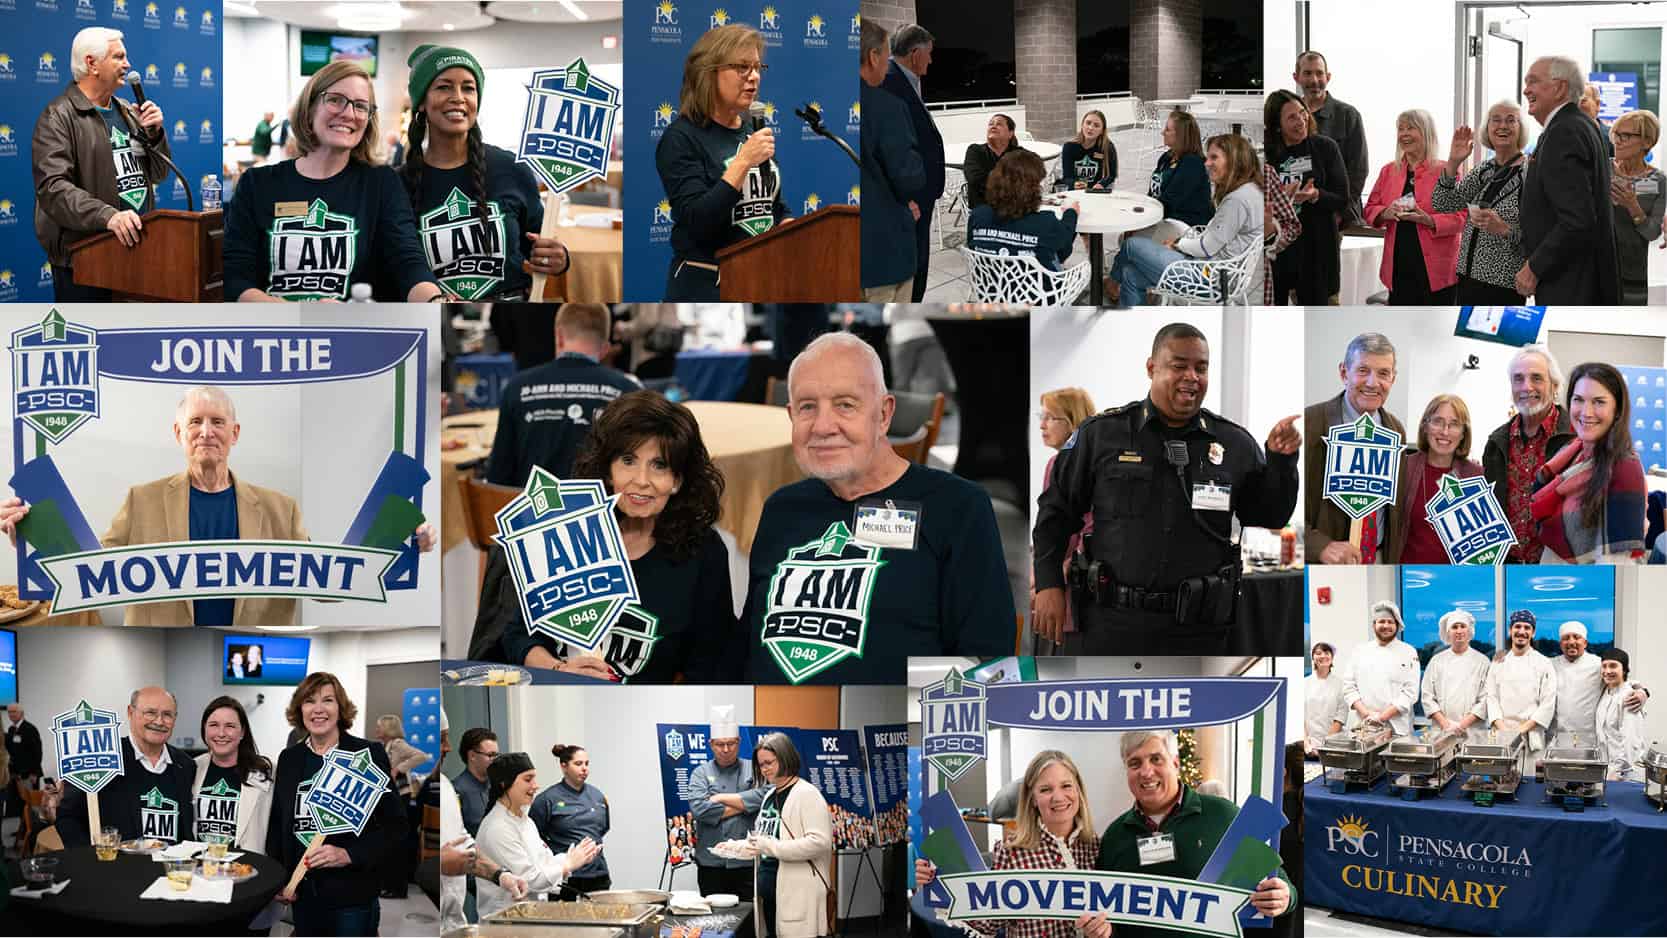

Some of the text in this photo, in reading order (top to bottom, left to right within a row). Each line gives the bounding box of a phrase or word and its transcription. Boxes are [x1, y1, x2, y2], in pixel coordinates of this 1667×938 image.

[655, 6, 679, 25] PSC
[806, 20, 827, 37] PSC
[534, 95, 606, 142] I AM
[551, 165, 573, 176] 1948
[280, 236, 347, 271] I AM
[429, 219, 501, 265] I AM
[456, 281, 477, 292] 1948
[151, 338, 332, 373] JOIN THE
[22, 351, 90, 387] I AM
[549, 383, 566, 393] AND
[566, 383, 599, 394] MICHAEL
[45, 416, 67, 427] 1948
[1334, 446, 1391, 476] I AM
[1350, 497, 1368, 505] 1948
[1440, 496, 1497, 542] I AM
[516, 514, 612, 585] I AM
[1477, 552, 1496, 563] 1948
[75, 552, 365, 600] MOVEMENT
[774, 567, 867, 610] I AM
[568, 609, 598, 627] 1948
[790, 646, 818, 661] 1948
[1029, 687, 1192, 721] JOIN THE
[928, 702, 980, 733] I AM
[62, 728, 113, 755] I AM
[688, 733, 706, 749] WE
[821, 737, 839, 751] PSC
[874, 731, 908, 748] BECAUSE
[83, 772, 100, 782] 1948
[320, 767, 375, 809] I AM
[206, 799, 236, 821] AM
[144, 814, 174, 836] AM
[1325, 825, 1533, 867] PSC PENSACOLA
[1399, 855, 1532, 878] STATE COLLEGE
[1341, 864, 1508, 909] CULINARY
[965, 878, 1220, 924] MOVEMENT
